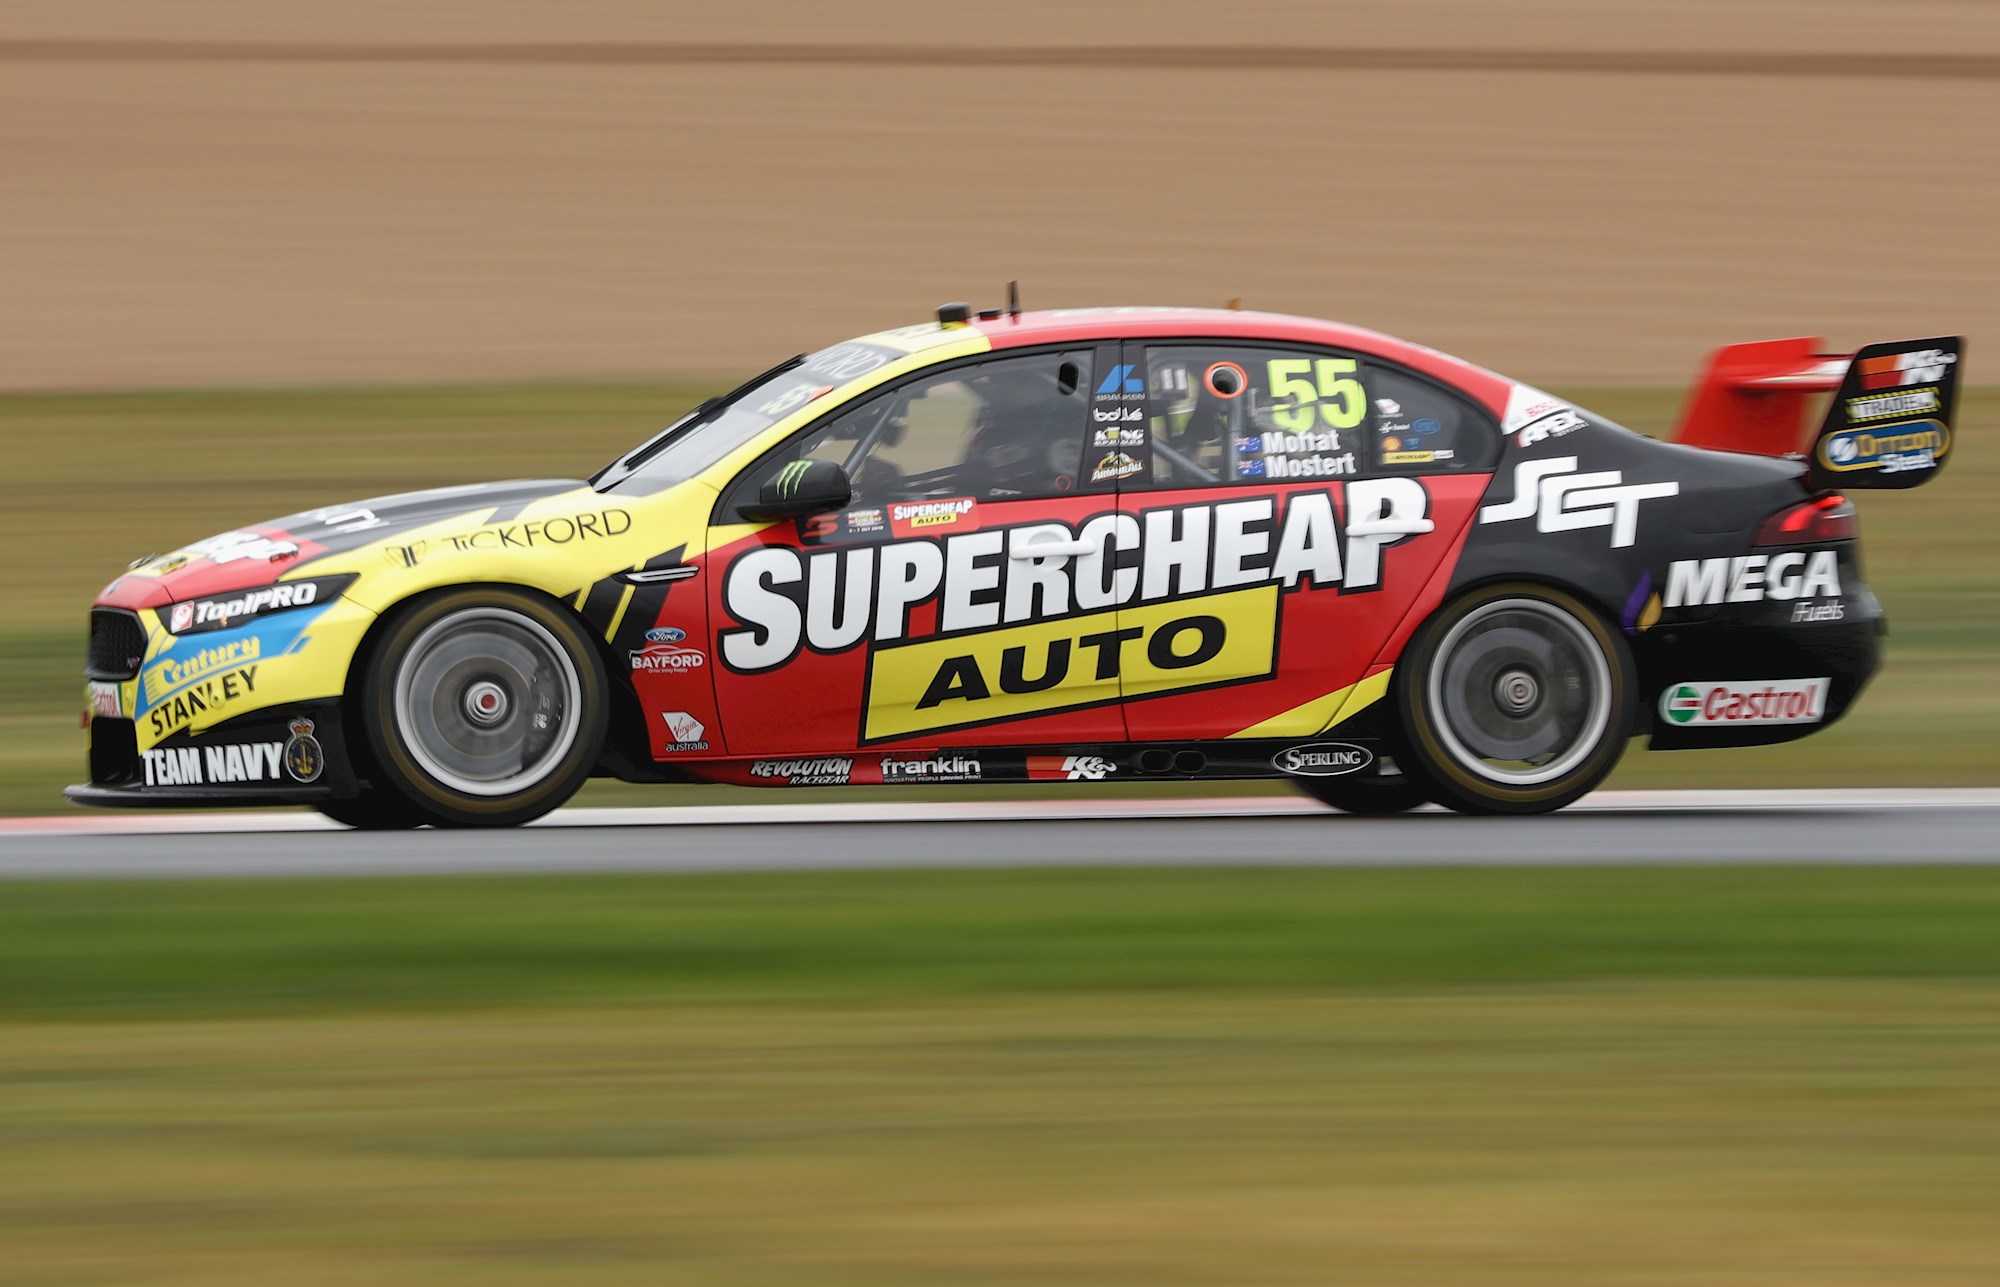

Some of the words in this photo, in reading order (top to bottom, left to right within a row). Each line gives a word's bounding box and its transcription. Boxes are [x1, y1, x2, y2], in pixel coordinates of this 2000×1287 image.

[1267, 359, 1367, 433] 55
[1265, 452, 1356, 478] Mostert
[1879, 449, 1937, 473] Steel
[893, 499, 973, 521] SUPERCHEAP
[1480, 455, 1679, 548] SCT
[917, 515, 951, 525] AUTO
[721, 477, 1434, 671] SUPERCHEAP
[1662, 551, 1842, 609] MEGA
[195, 583, 318, 624] ToolPRO
[1790, 600, 1844, 622] Fuels
[652, 631, 679, 641] Ford
[631, 655, 704, 669] BAYFORD
[913, 614, 1229, 710] AUTO
[1702, 685, 1818, 720] Castrol
[673, 717, 699, 740] Virgin
[666, 742, 708, 752] australia
[142, 748, 202, 786] TEAM
[207, 742, 284, 781] NAVY
[750, 758, 853, 777] REVOLUTION
[880, 757, 981, 775] franklin
[1061, 756, 1117, 780] K&N
[1285, 749, 1361, 770] SPERLING
[789, 775, 850, 785] RACEGEAR
